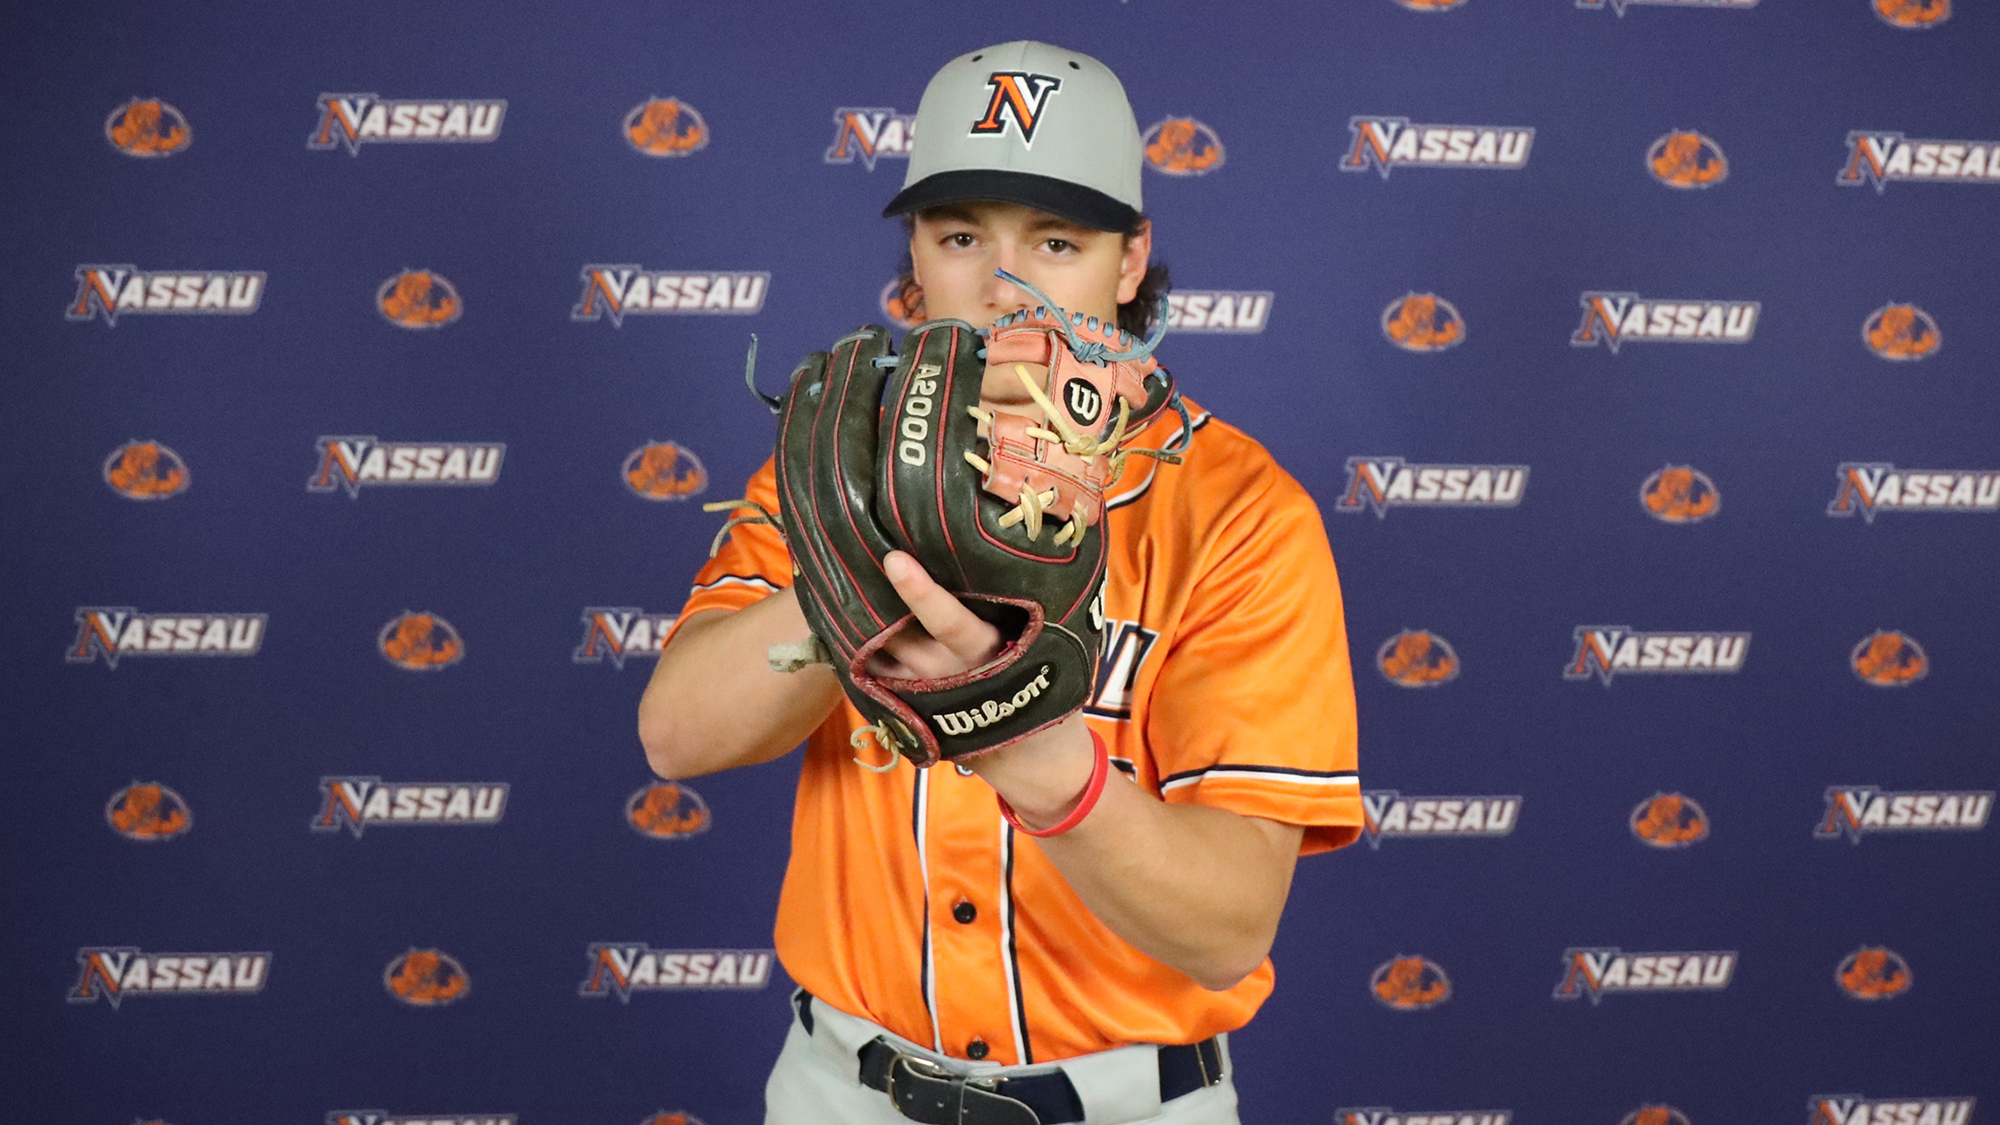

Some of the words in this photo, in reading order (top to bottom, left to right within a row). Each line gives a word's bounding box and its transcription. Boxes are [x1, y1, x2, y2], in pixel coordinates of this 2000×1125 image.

[309, 94, 506, 154] NASSAU
[968, 71, 1063, 150] N
[1340, 117, 1534, 178] NASSAU
[67, 265, 265, 325] NASSAU
[572, 265, 769, 325] NASSAU
[1571, 293, 1759, 352] NASSAU
[899, 363, 942, 466] A2000
[308, 436, 505, 497] NASSAU
[1338, 458, 1529, 518] NASSAU
[67, 607, 267, 667] NASSAU
[1564, 626, 1751, 684] NASSAU
[932, 672, 1050, 736] Wilson
[312, 777, 509, 837] NASSAU
[1815, 786, 1995, 843] NASSAU
[67, 947, 272, 1008] NASSAU
[580, 943, 775, 1003] NASSAU
[1553, 948, 1738, 1004] NASSAU
